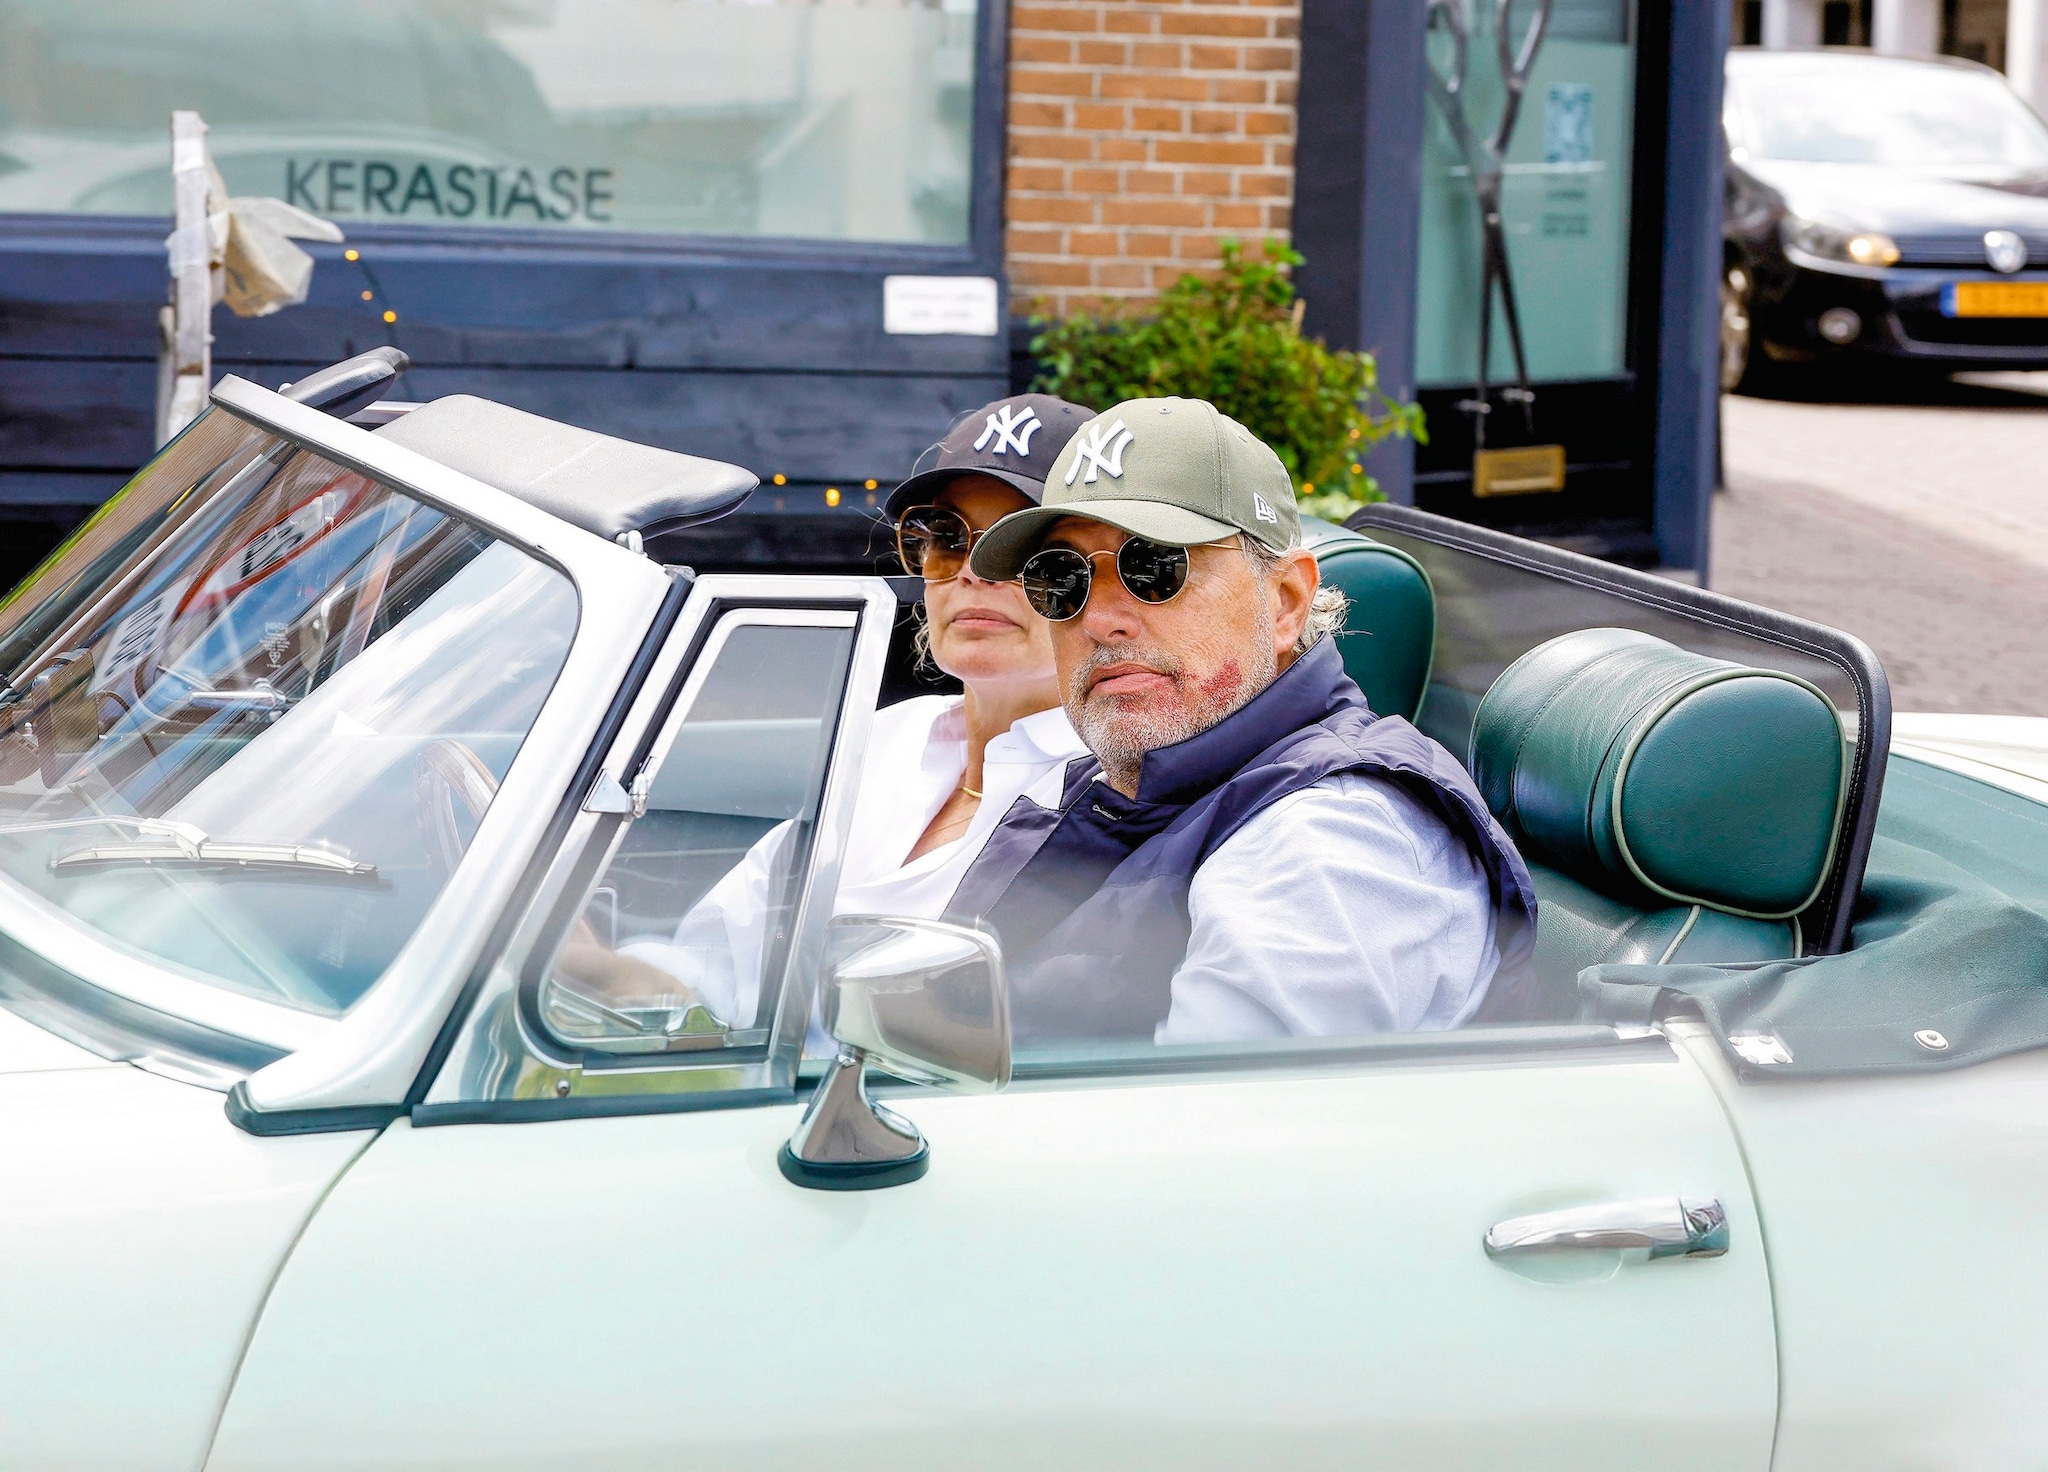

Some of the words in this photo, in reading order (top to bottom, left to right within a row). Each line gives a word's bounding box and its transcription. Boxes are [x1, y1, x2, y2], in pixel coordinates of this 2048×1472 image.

[286, 159, 614, 221] KERASTASE
[973, 404, 1042, 457] NY
[1064, 418, 1134, 486] NY
